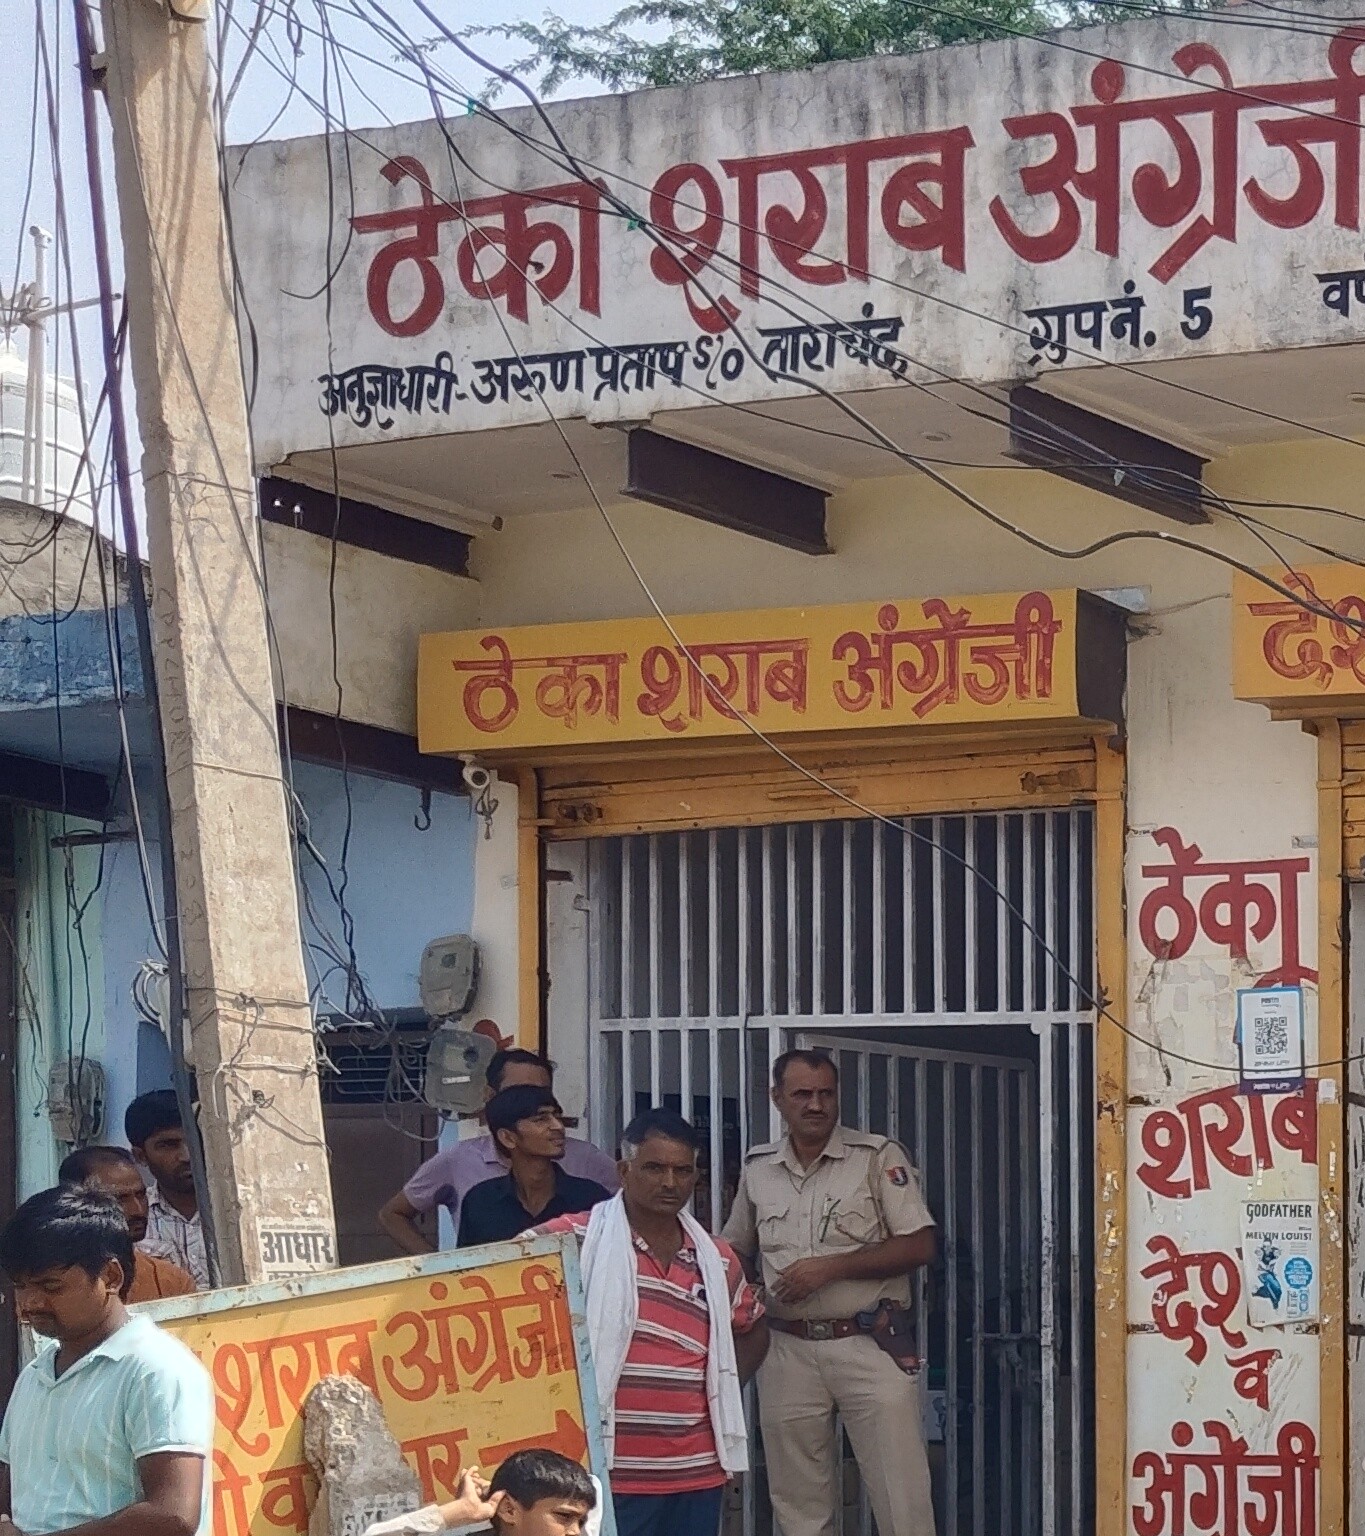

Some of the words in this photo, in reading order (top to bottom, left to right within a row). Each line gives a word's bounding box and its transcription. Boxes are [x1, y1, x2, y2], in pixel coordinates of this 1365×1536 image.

[351, 155, 606, 338] ठेका
[649, 125, 975, 334] शराब
[1181, 286, 1213, 341] 5
[1139, 826, 1311, 972] ठेका
[260, 1231, 334, 1264] आधार
[1224, 1348, 1283, 1412] व
